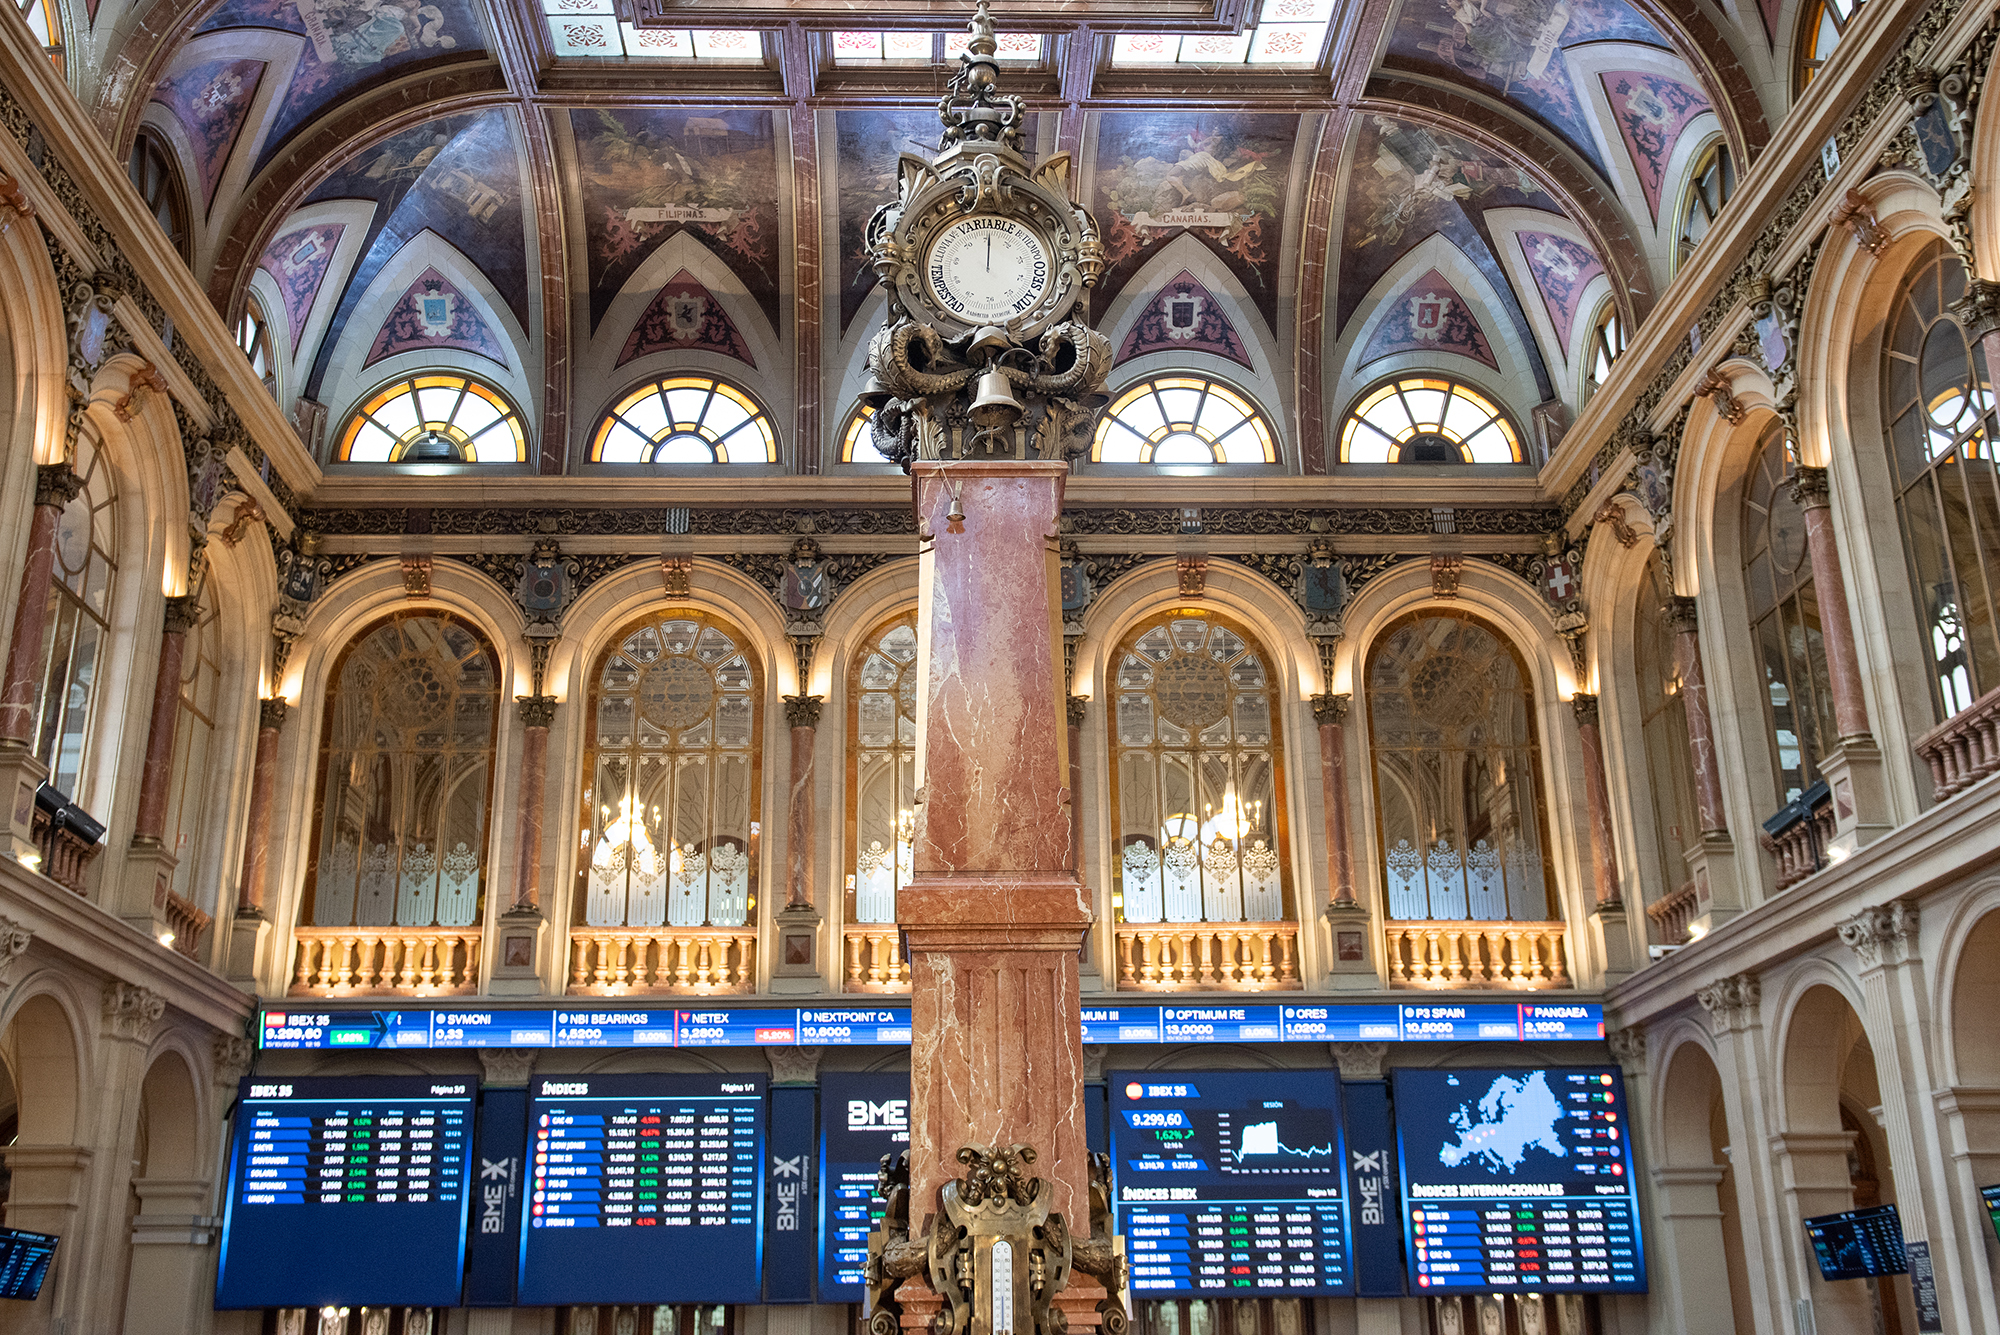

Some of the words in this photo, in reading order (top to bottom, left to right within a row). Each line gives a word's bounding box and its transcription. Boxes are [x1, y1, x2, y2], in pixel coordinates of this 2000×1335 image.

[658, 210, 707, 219] FILIPINAS.
[1163, 215, 1211, 223] CANARIAS.
[957, 219, 1017, 235] VARIABLE
[1022, 235, 1042, 260] TIEMPO
[931, 265, 965, 313] TEMPESTAD
[1012, 290, 1037, 314] MUY
[1031, 261, 1046, 291] SECO
[692, 1013, 729, 1024] NETEX
[814, 1013, 876, 1022] NEXTPOINT
[878, 1012, 894, 1022] CA
[1081, 1011, 1107, 1021] MUM
[1110, 1011, 1119, 1021] III
[1177, 1010, 1228, 1020] OPTIMUM
[1230, 1010, 1245, 1020] RE
[1296, 1009, 1328, 1020] ORES
[1415, 1009, 1430, 1018] P3
[1432, 1008, 1466, 1019] SPAIN
[1535, 1008, 1588, 1018] PANGAEA
[288, 1015, 315, 1026] IBEX
[317, 1015, 330, 1026] 35
[448, 1014, 491, 1025] SVMONI
[570, 1014, 589, 1025] NBI
[591, 1014, 648, 1025] BEARINGS
[802, 1027, 851, 1038] 10,6000
[1165, 1025, 1214, 1036] 13,0000
[1245, 1028, 1273, 1037] 0,00%
[1286, 1023, 1326, 1035] 1,0200
[1365, 1027, 1393, 1037] 0,00%
[1405, 1023, 1454, 1033] 10,5000
[1484, 1026, 1513, 1036] 0,00%
[1524, 1022, 1565, 1033] 2,1000
[266, 1028, 322, 1040] 9.299,60
[337, 1033, 364, 1043] 1,62%
[436, 1029, 464, 1040] 0,33
[516, 1033, 545, 1043] 0,00%
[558, 1029, 602, 1040] 4,5200
[639, 1032, 667, 1042] 0,00%
[681, 1028, 724, 1040] 3,2800
[759, 1031, 791, 1041] -5,20%
[1125, 1029, 1153, 1038] 0,00%
[250, 1085, 278, 1097] IBEX
[279, 1085, 293, 1097] 35
[542, 1081, 589, 1095] ÍNDICES
[721, 1084, 744, 1093] Página
[745, 1084, 755, 1092] 1/1
[1148, 1087, 1173, 1097] IBEX
[1174, 1087, 1187, 1097] 35
[1263, 1101, 1283, 1109] SESIÓN
[848, 1100, 907, 1125] BME
[1132, 1114, 1182, 1127] 9.299,60
[1155, 1130, 1183, 1141] 1,62%
[252, 1156, 289, 1165] SANTANDER
[249, 1182, 287, 1190] TELEFONICA
[1412, 1183, 1459, 1197] ÍNDICES
[1459, 1184, 1565, 1197] INTERNACIONALES
[1123, 1186, 1170, 1200] ÍNDICES
[1170, 1188, 1197, 1200] IBEX
[1359, 1177, 1380, 1224] BME
[482, 1185, 503, 1233] BME
[638, 1205, 657, 1213] 0,00%
[777, 1183, 795, 1231] BME
